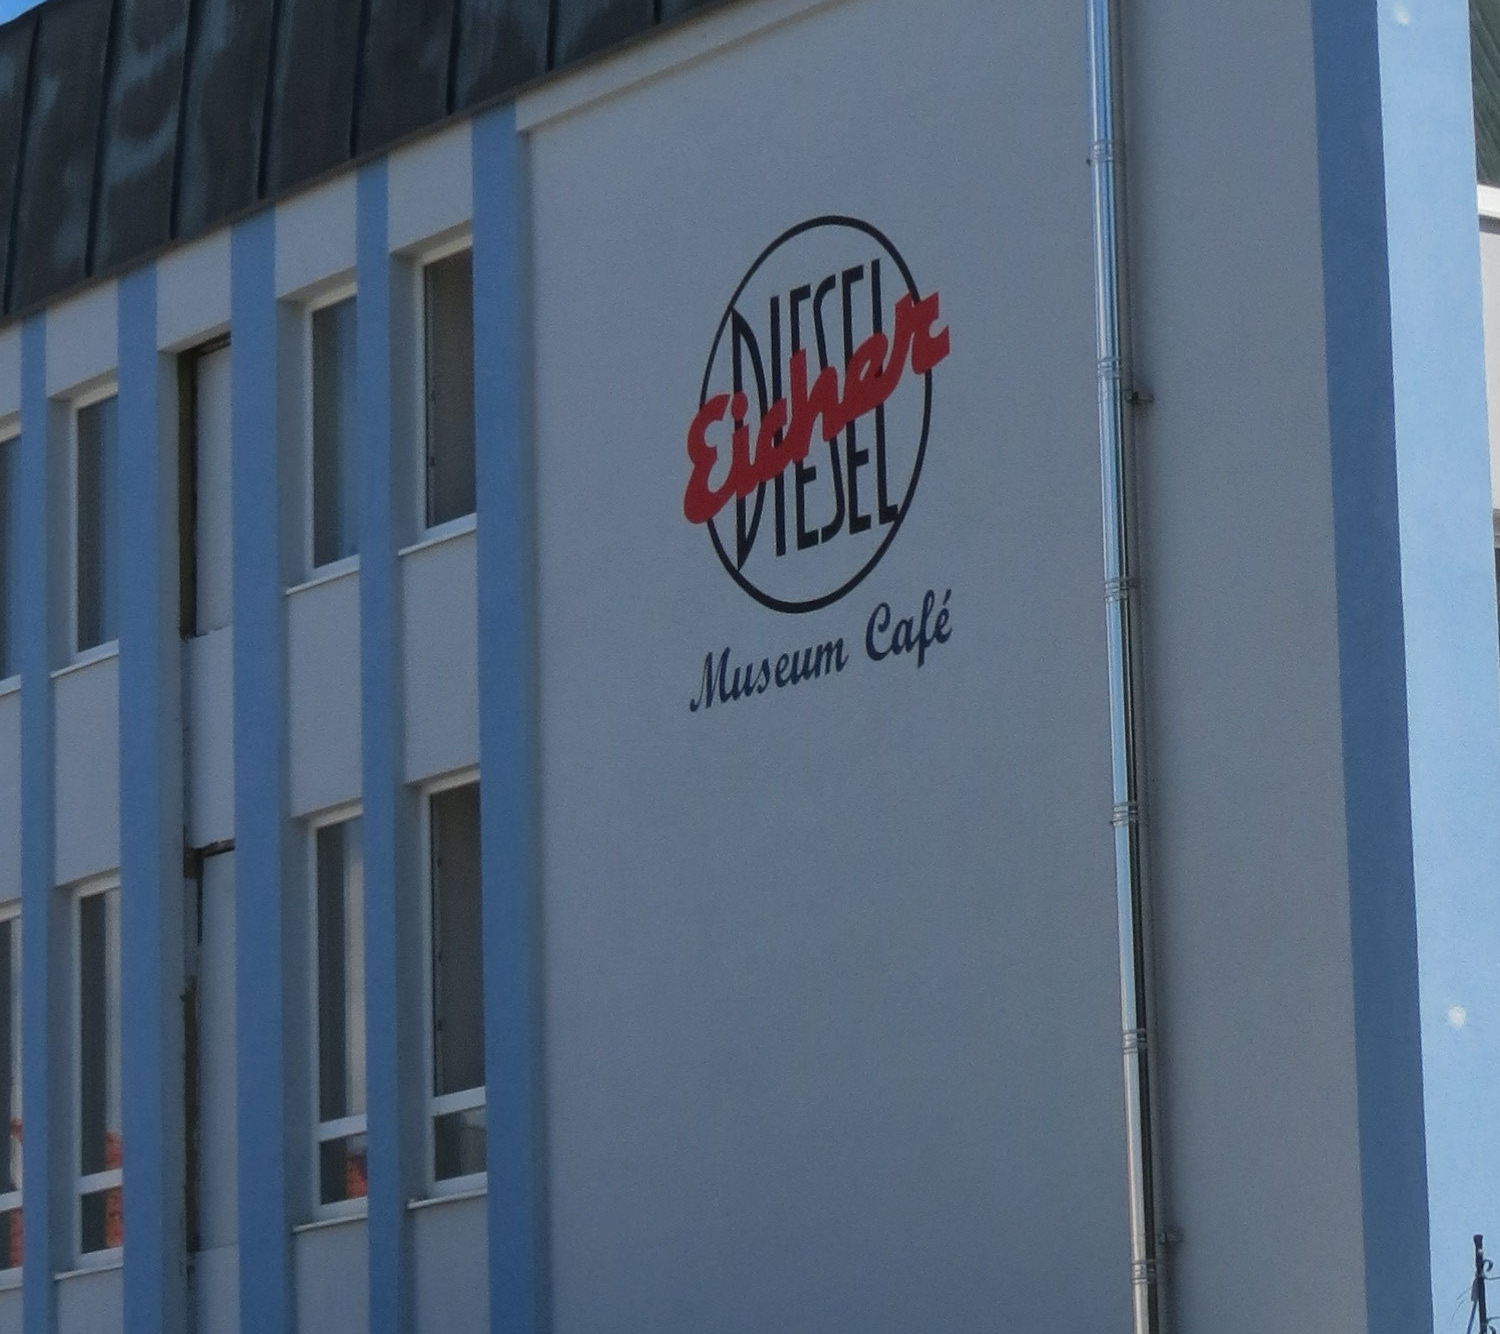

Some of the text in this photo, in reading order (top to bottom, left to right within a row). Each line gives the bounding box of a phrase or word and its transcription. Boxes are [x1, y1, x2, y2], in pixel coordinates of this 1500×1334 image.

[683, 290, 951, 525] Eicher
[731, 259, 899, 571] DIESEL
[689, 588, 952, 713] Museum Café
